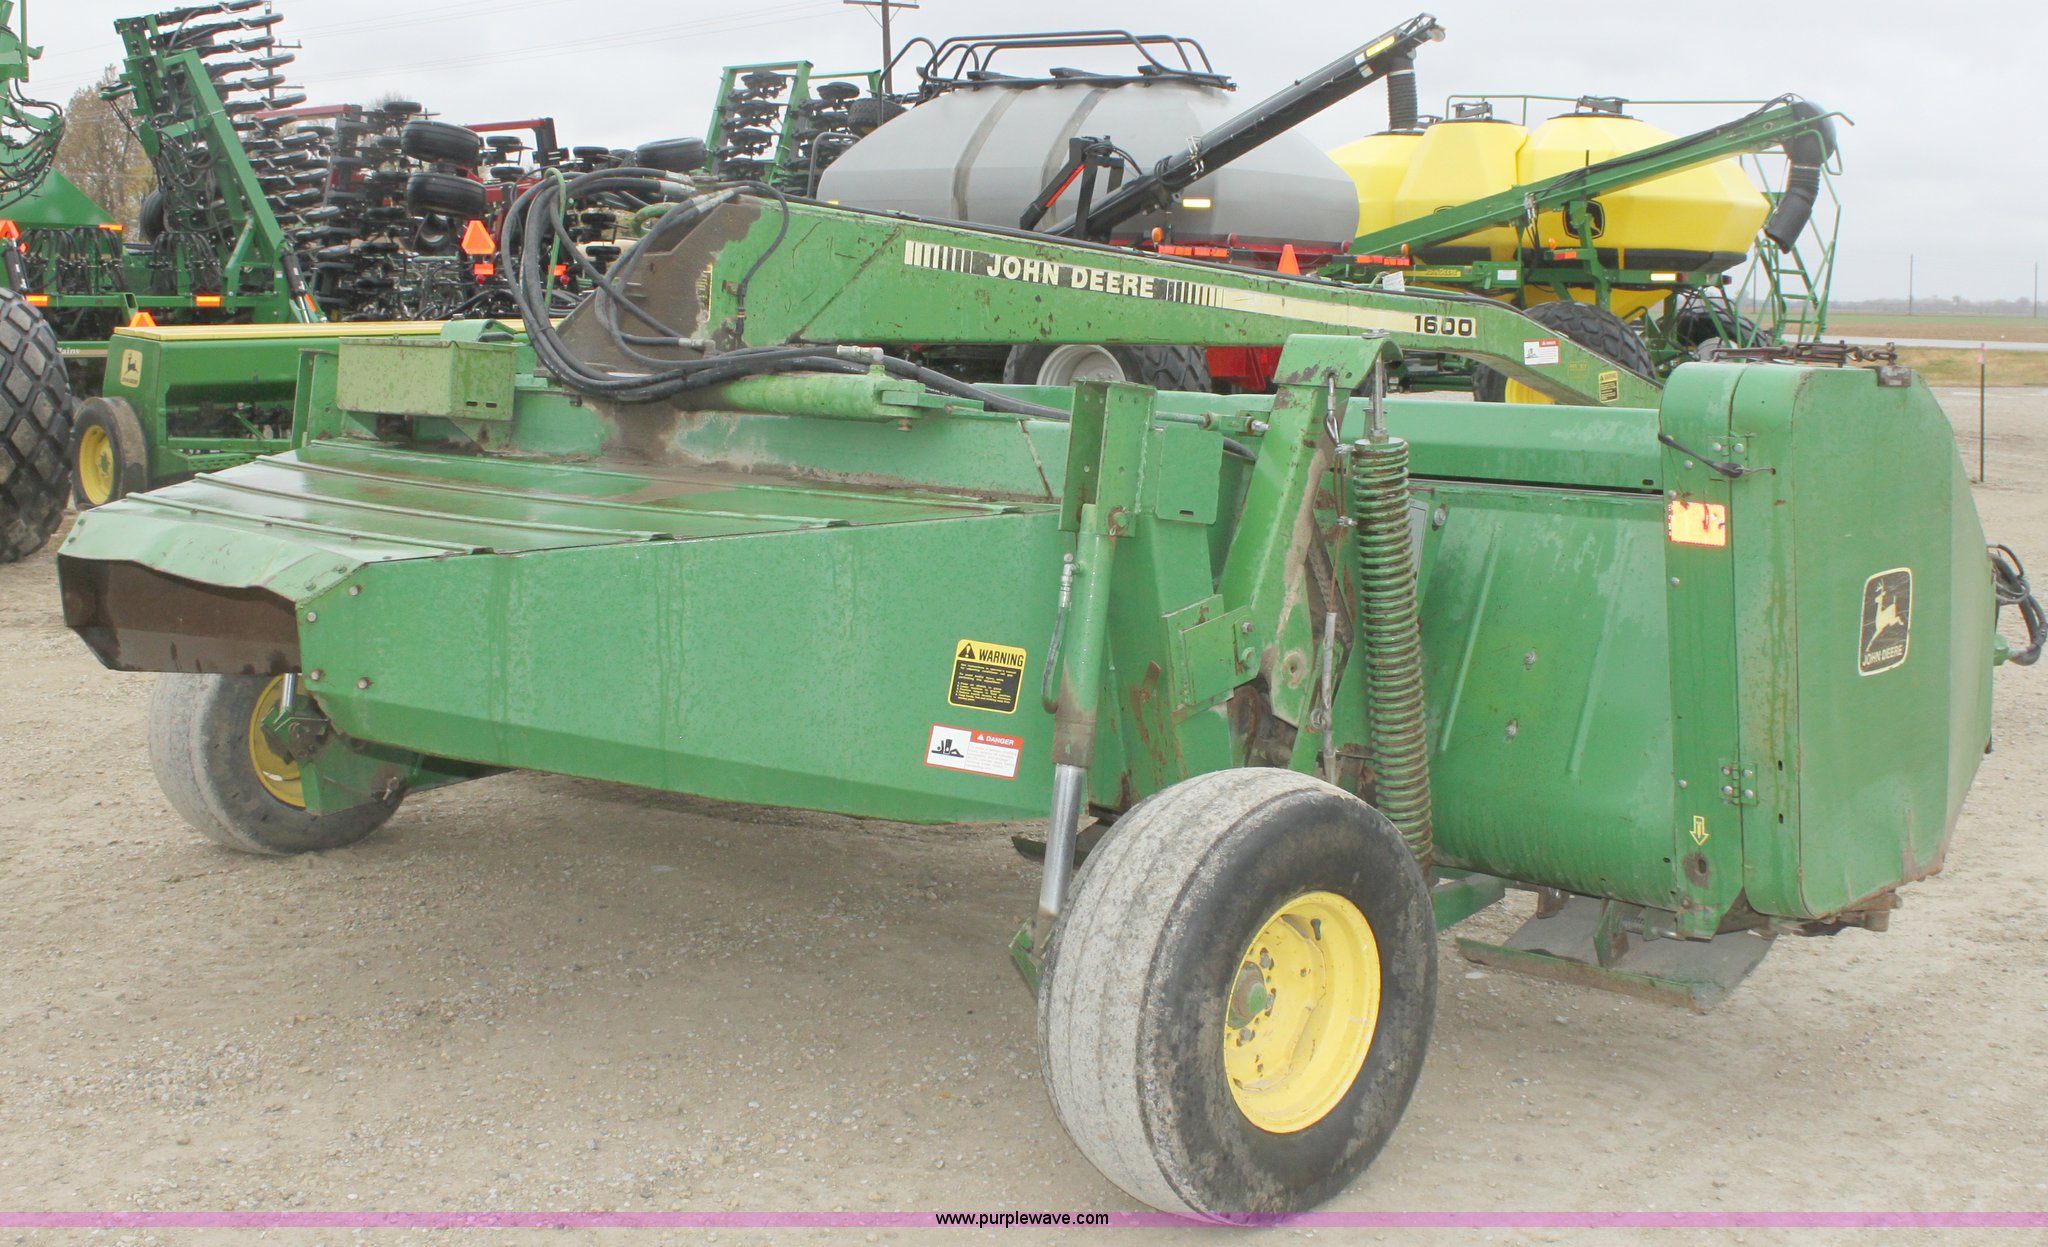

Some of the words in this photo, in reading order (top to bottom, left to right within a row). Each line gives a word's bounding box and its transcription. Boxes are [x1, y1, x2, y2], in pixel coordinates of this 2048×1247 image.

[987, 253, 1059, 286] JOHN
[1071, 267, 1154, 299] DEERE
[1414, 315, 1472, 337] 1600
[979, 649, 1024, 667] WARNING
[1862, 651, 1882, 666] JOHN
[1882, 644, 1904, 660] DEERE
[986, 735, 1014, 746] DANGER
